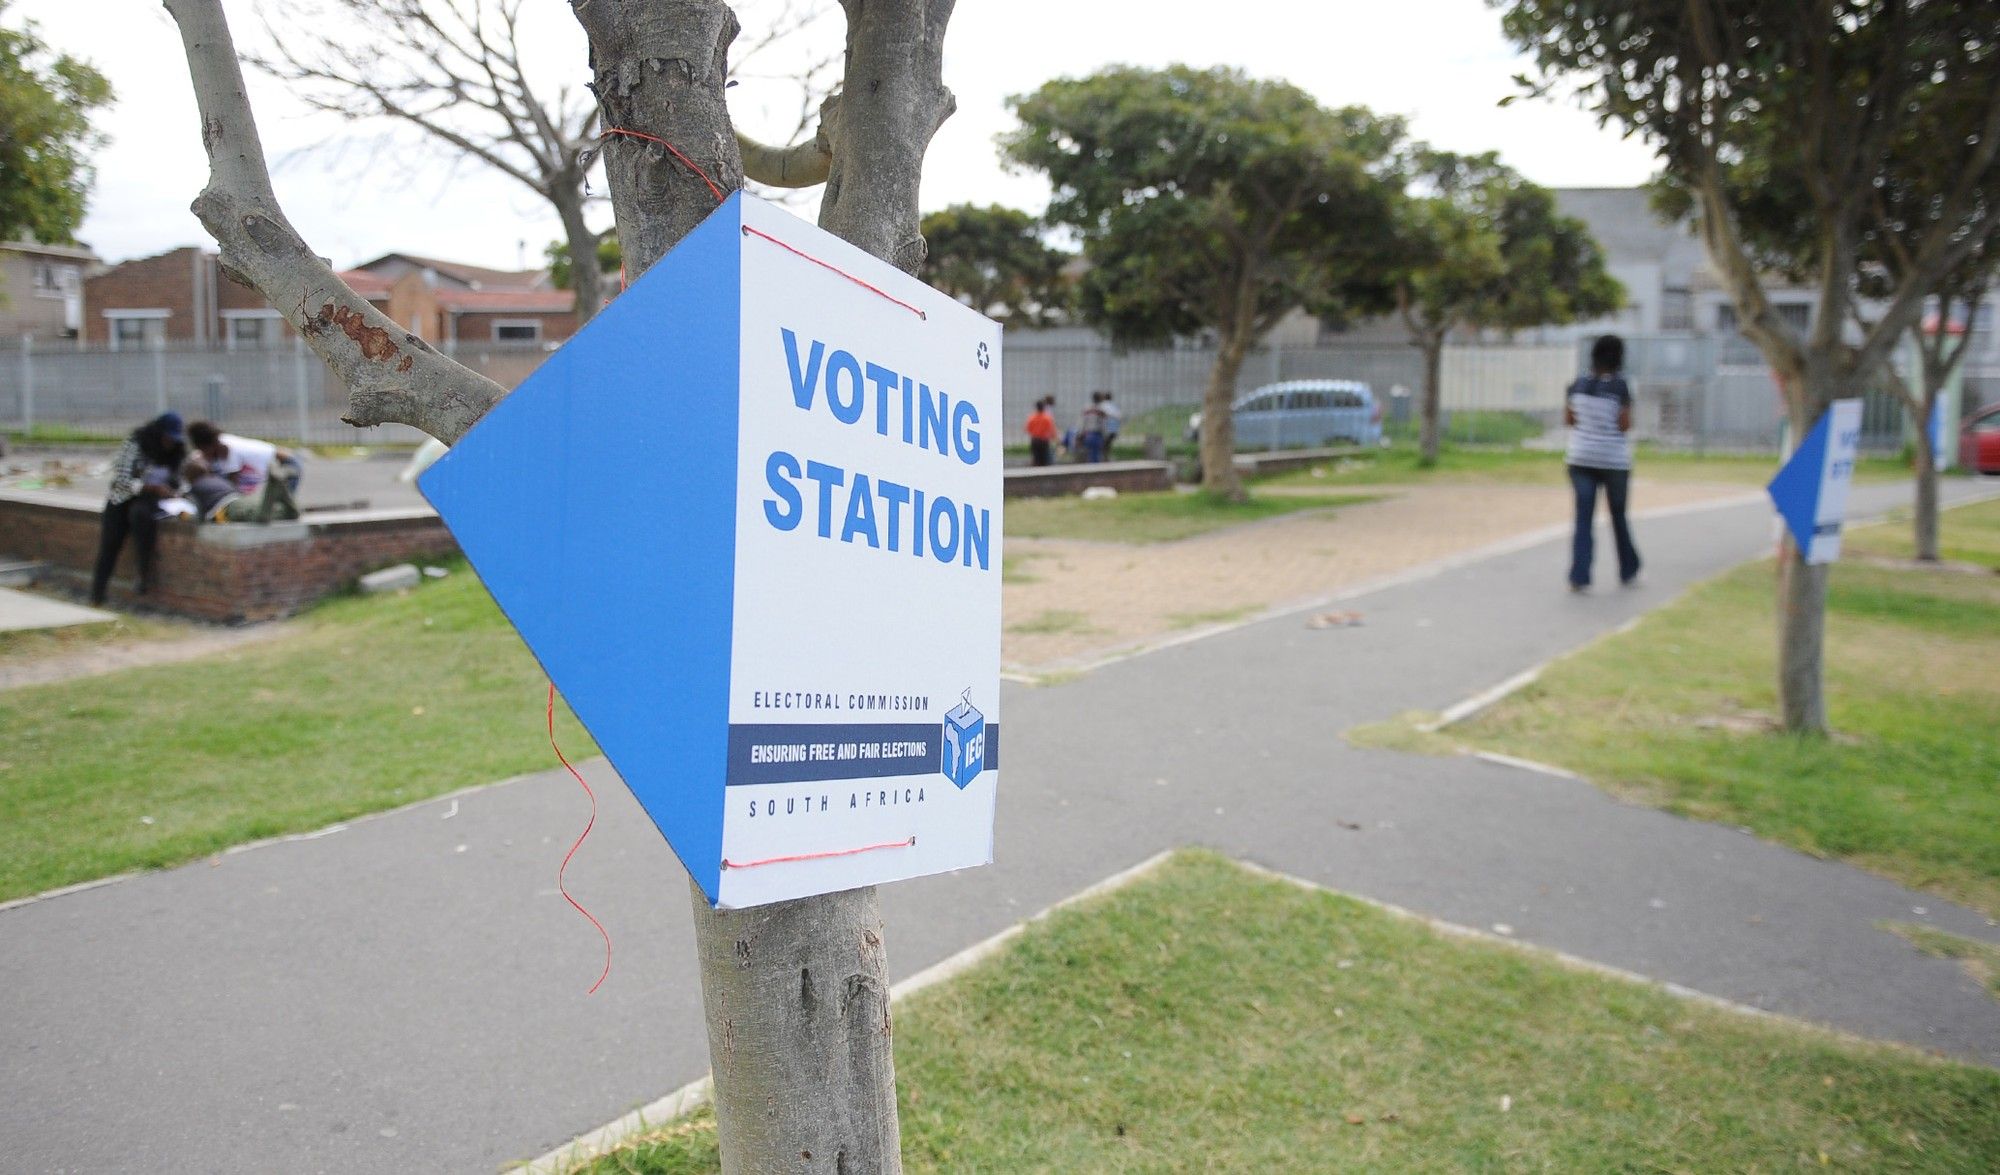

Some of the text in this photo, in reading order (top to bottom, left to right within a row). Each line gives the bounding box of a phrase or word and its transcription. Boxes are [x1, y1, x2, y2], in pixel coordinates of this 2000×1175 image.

[780, 326, 981, 466] VOTING
[762, 450, 990, 571] STATION
[753, 691, 929, 711] ELECTORAL COMMISSION
[751, 741, 927, 764] ENSURING FREE AND FAIR ELECTIONS
[965, 732, 983, 768] IEC
[749, 787, 926, 818] SOUTH AFRICA
